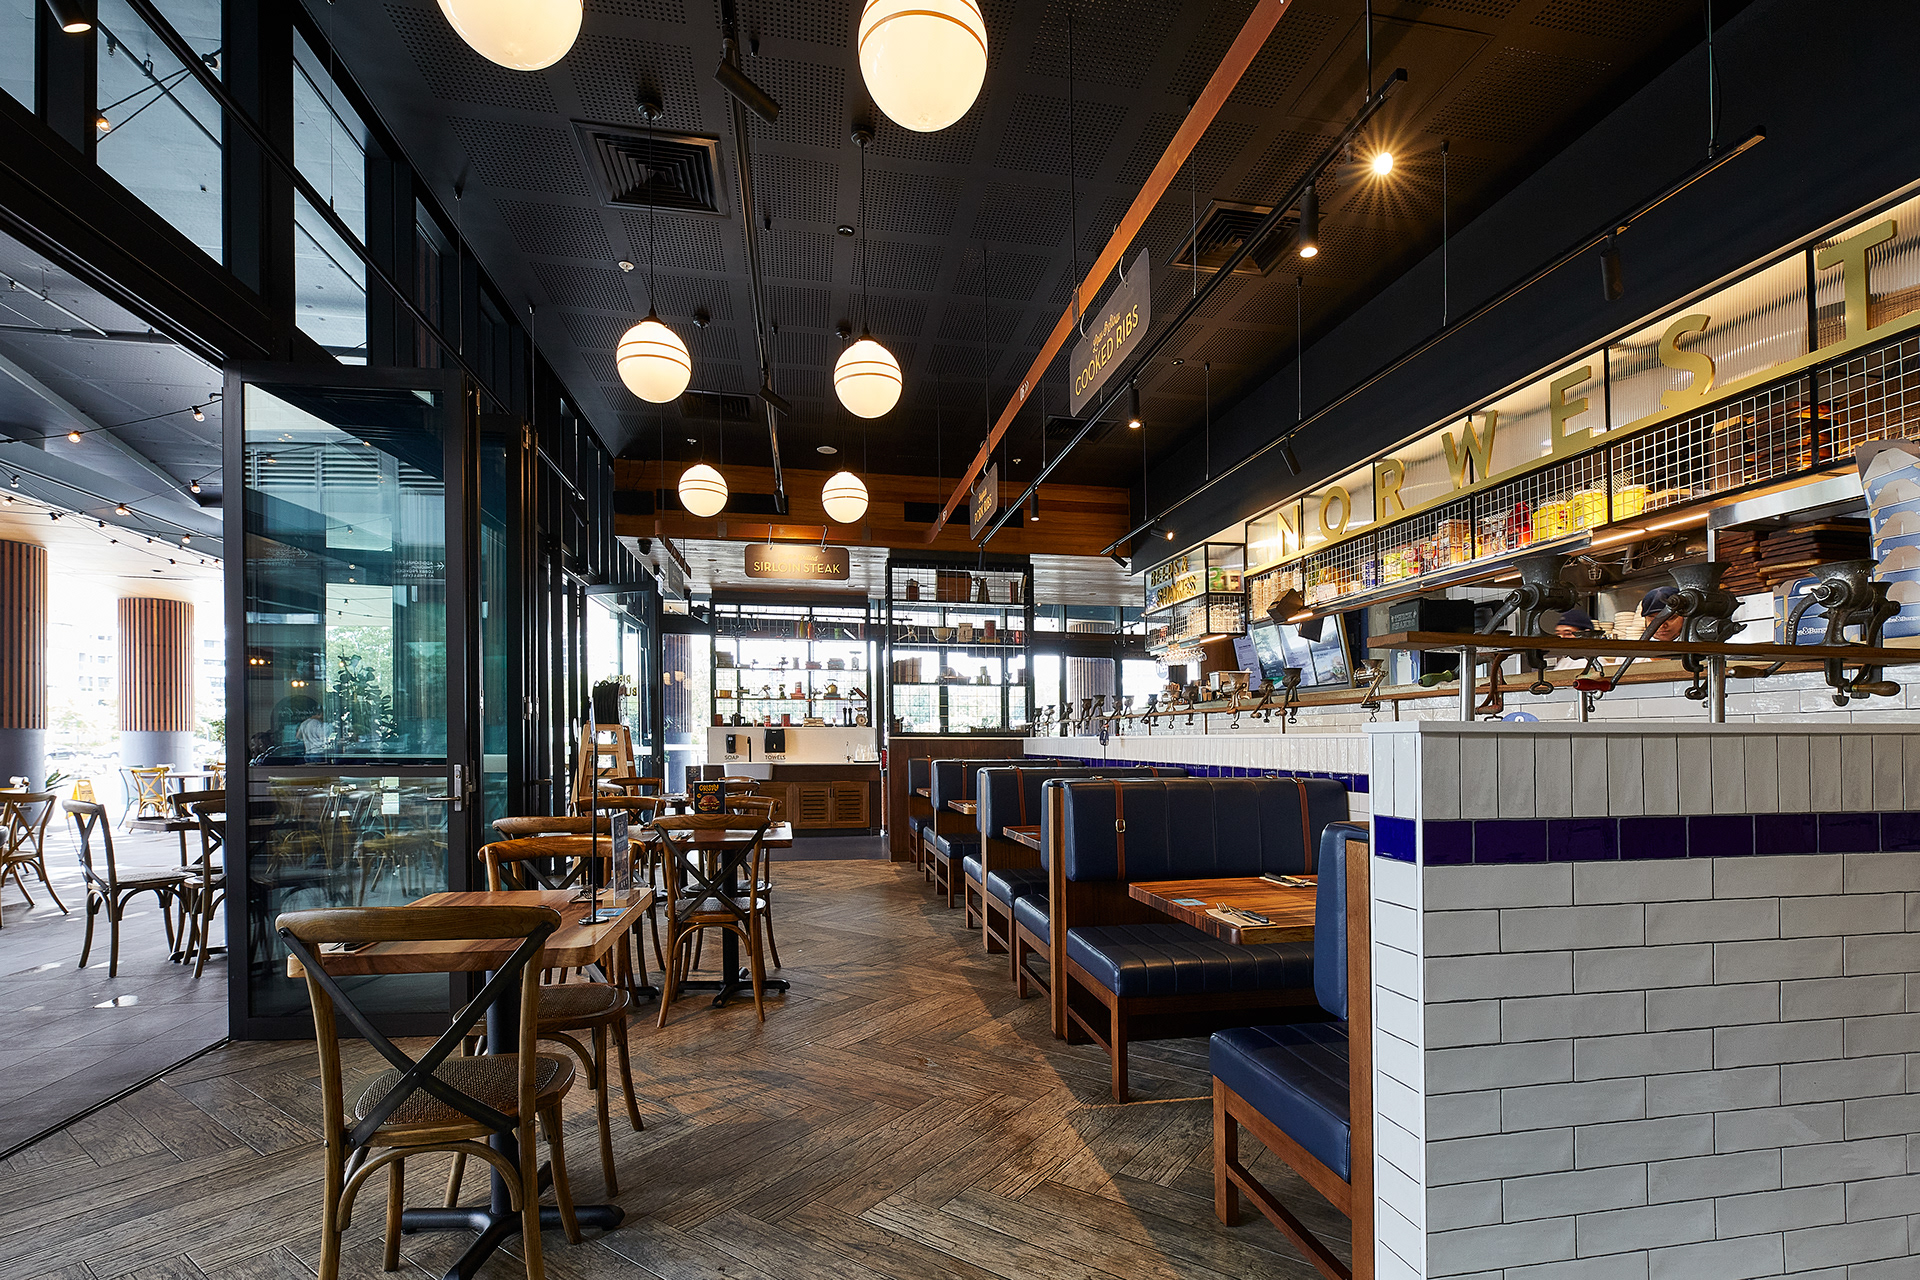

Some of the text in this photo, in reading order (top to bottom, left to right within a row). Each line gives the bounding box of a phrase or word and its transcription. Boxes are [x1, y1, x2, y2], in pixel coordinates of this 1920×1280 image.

[1074, 303, 1140, 397] COOKED RIBS
[1275, 218, 1898, 558] NORWEST
[753, 560, 841, 575] SIRLOIN STEAK
[1150, 555, 1189, 587] BEERS &
